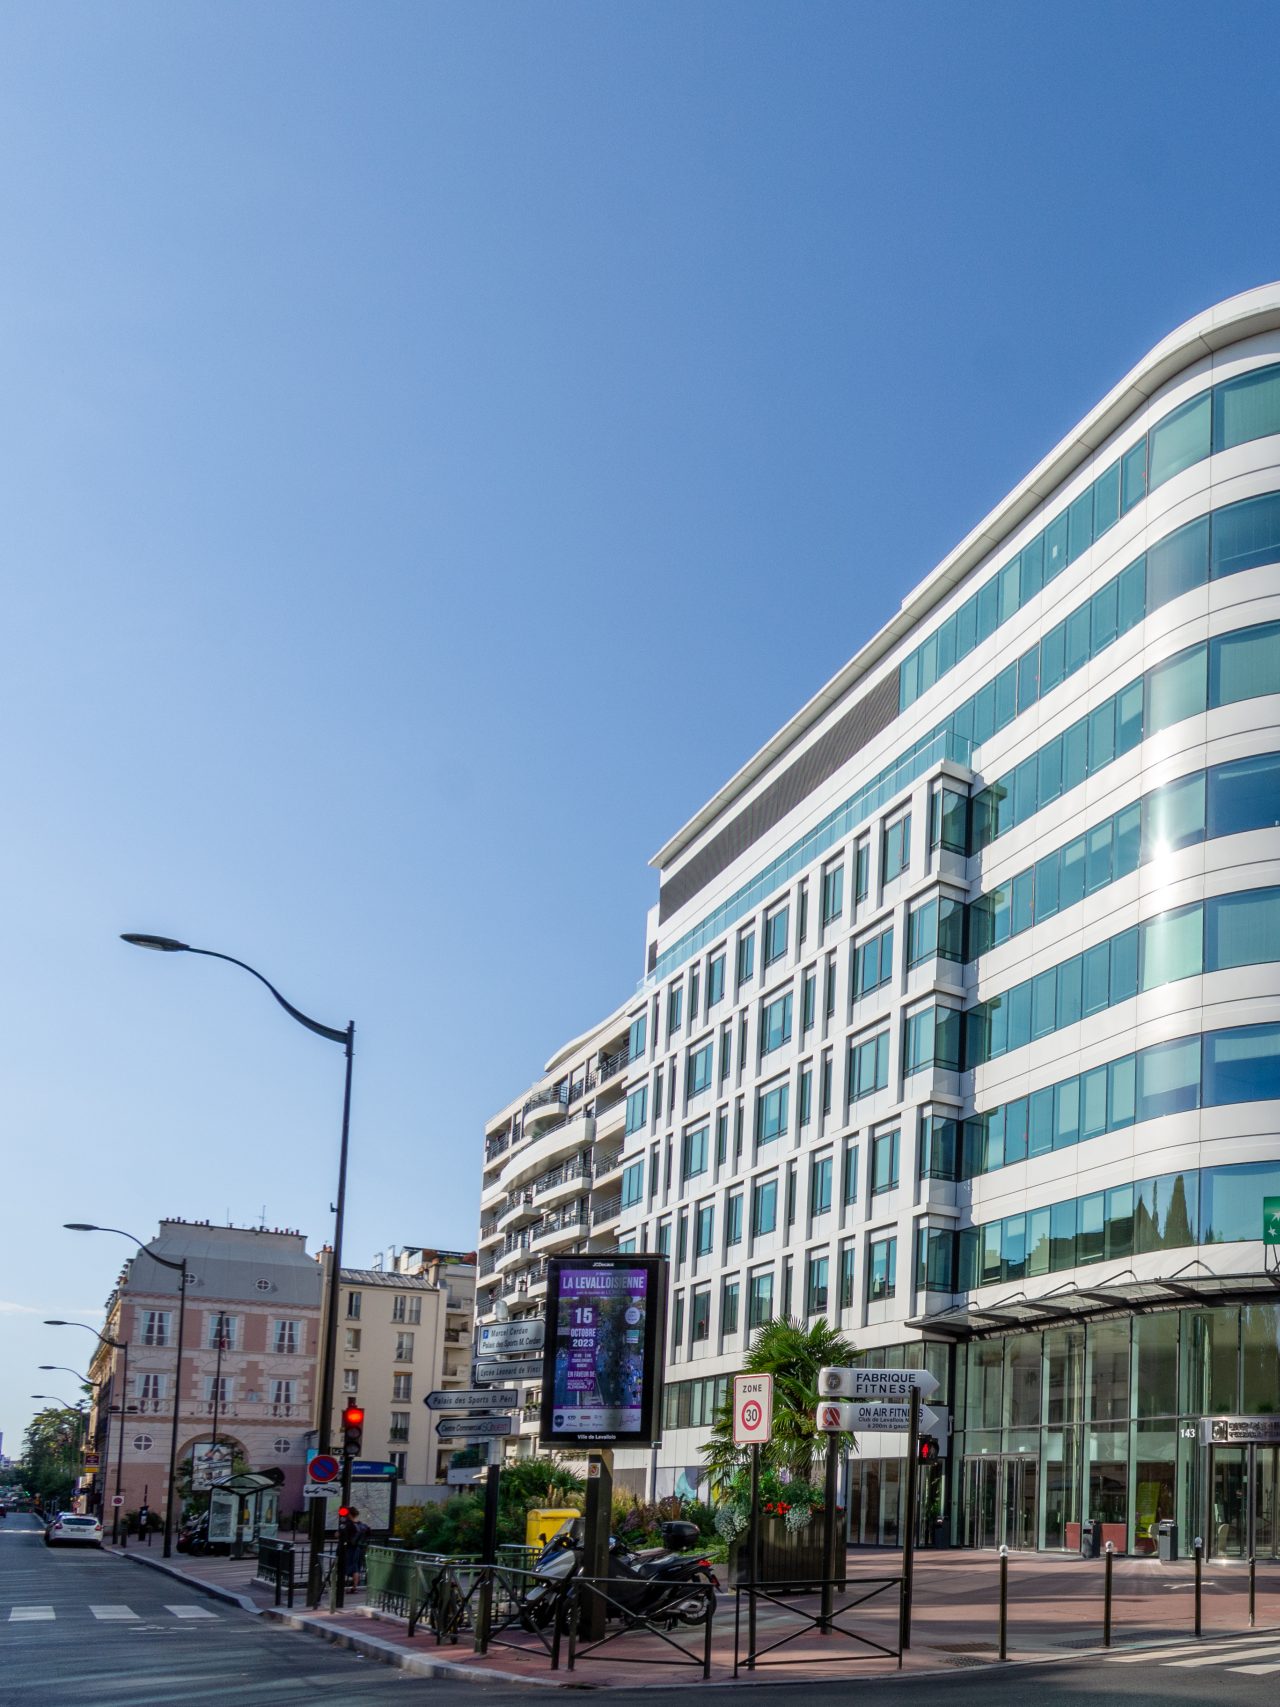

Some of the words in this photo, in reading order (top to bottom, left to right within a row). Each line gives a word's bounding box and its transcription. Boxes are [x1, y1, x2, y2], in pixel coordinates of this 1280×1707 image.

[563, 1277, 574, 1289] LA
[576, 1276, 644, 1289] LEVALLOISIENNE
[575, 1307, 593, 1324] 15
[491, 1328, 509, 1338] Marcel
[510, 1327, 529, 1336] Cerdan
[570, 1328, 597, 1338] OCTOBRE
[572, 1339, 594, 1347] 2023
[480, 1369, 495, 1377] Lycée
[496, 1367, 517, 1376] Léonard
[518, 1366, 525, 1374] de
[856, 1373, 916, 1383] FABRIQUE
[742, 1384, 763, 1394] ZONE
[432, 1396, 452, 1405] Palais
[454, 1396, 466, 1404] des
[467, 1396, 489, 1405] Sports
[500, 1394, 513, 1403] Péri
[745, 1408, 758, 1422] 30
[858, 1407, 871, 1417] ON
[873, 1407, 887, 1417] AIR
[889, 1407, 924, 1418] FITNS
[1180, 1428, 1196, 1438] 143
